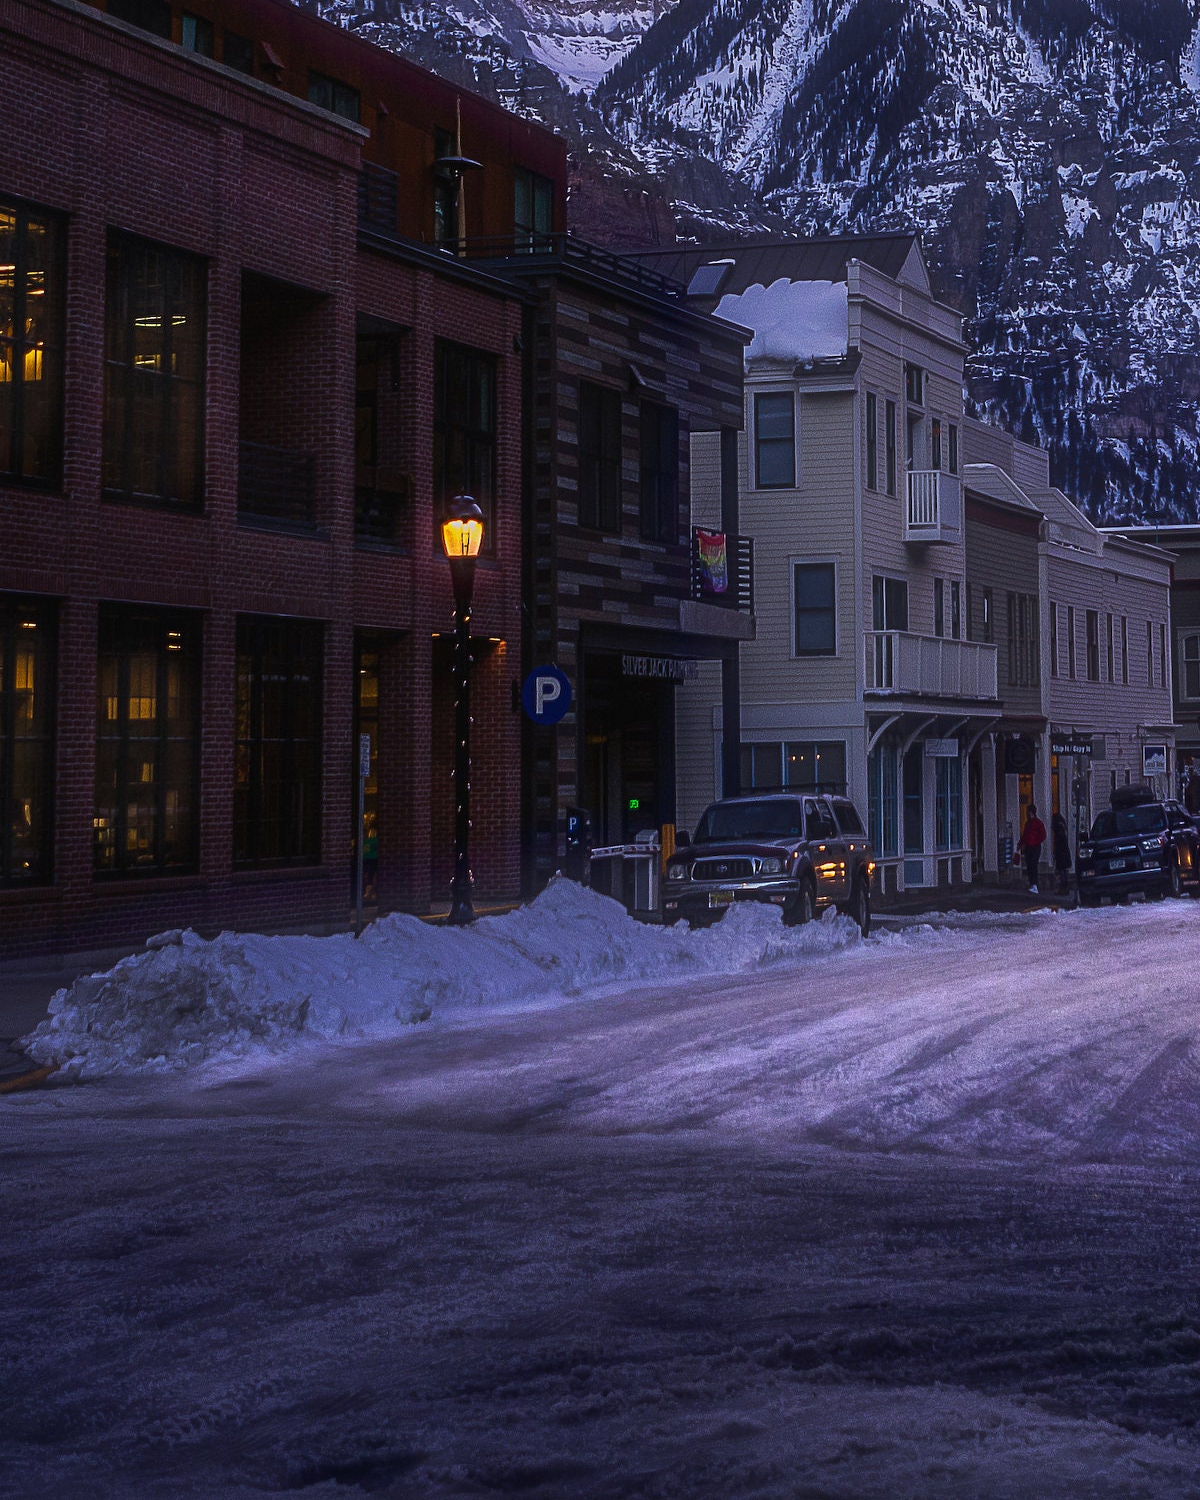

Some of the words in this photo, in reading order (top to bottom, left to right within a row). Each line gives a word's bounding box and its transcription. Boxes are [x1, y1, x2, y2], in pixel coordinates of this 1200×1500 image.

[622, 653, 648, 676] SILVER
[648, 658, 667, 677] JACK
[535, 676, 561, 714] P
[569, 817, 577, 831] P
